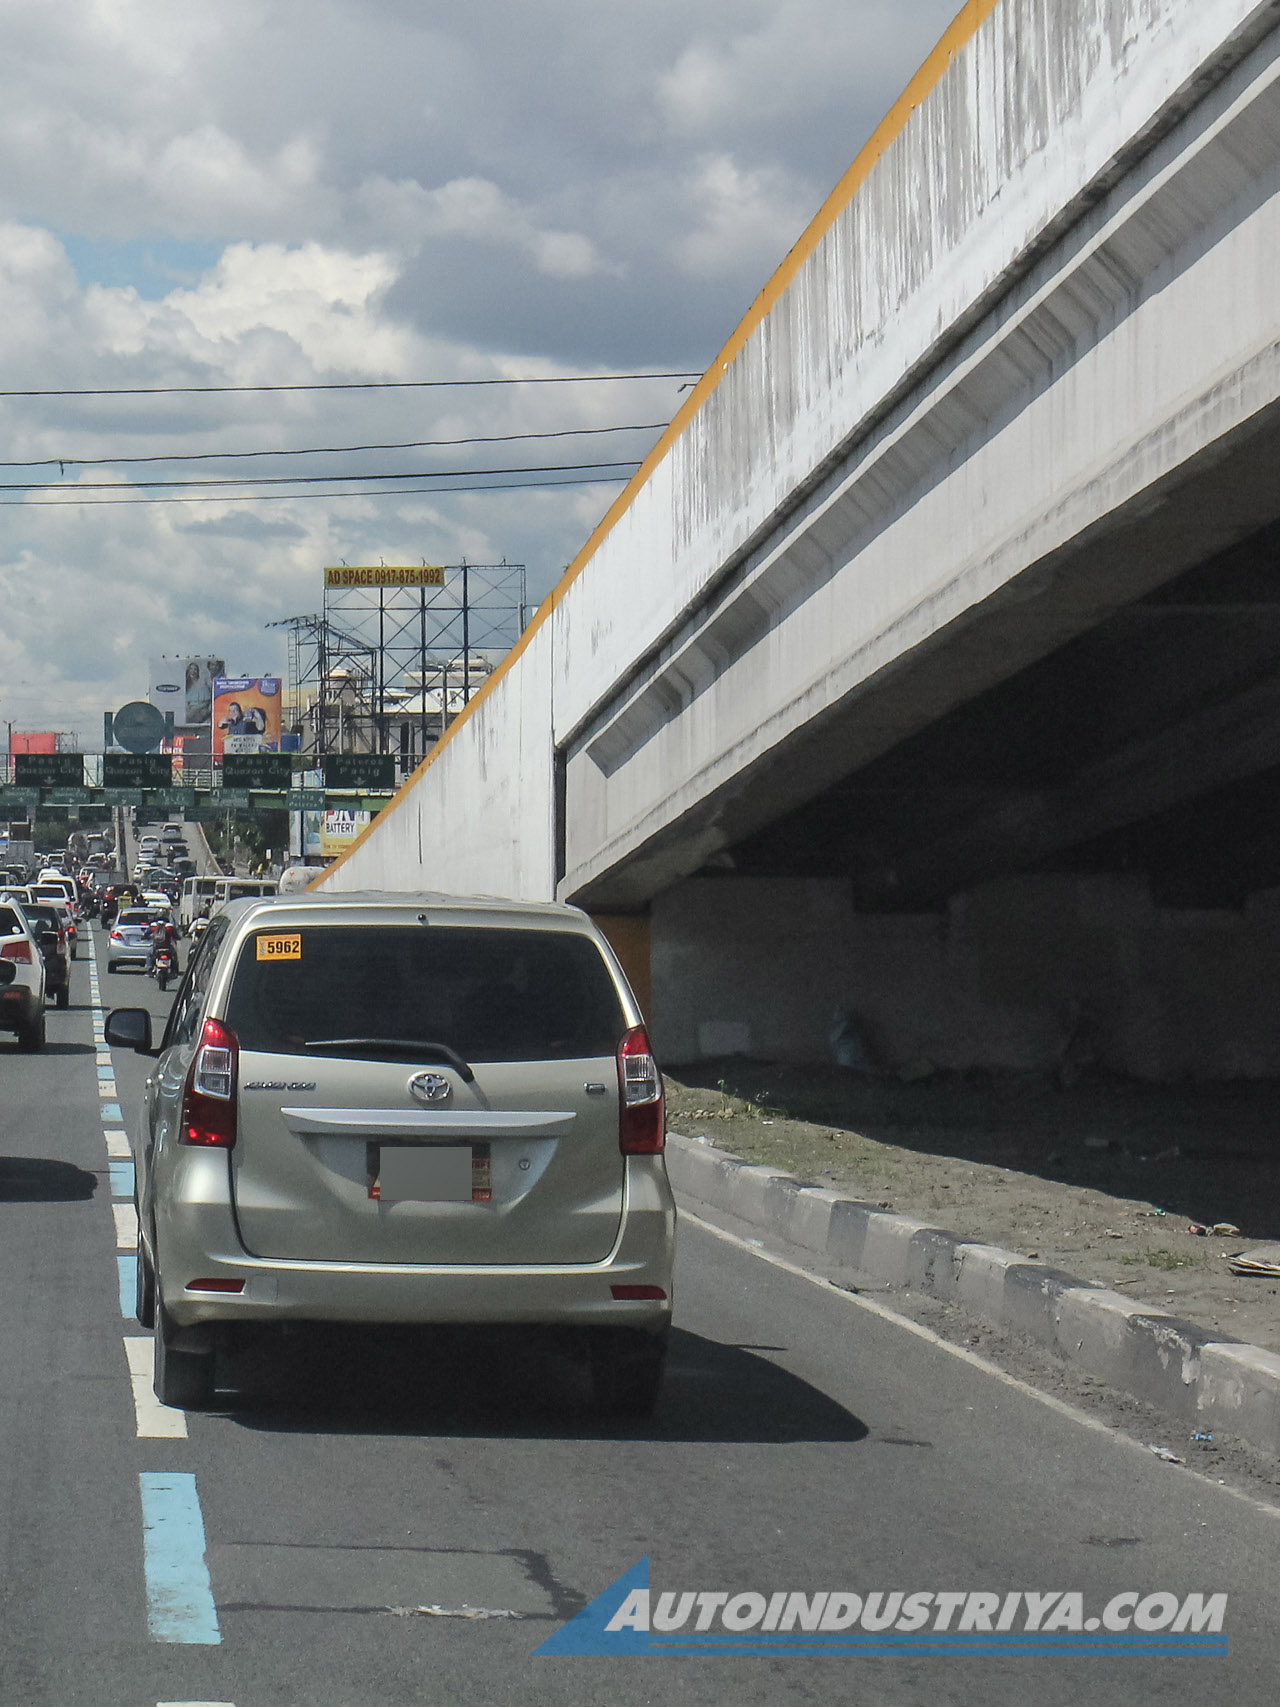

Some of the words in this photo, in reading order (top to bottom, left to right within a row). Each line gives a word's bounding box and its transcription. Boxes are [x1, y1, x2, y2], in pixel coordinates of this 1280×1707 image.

[328, 570, 340, 584] AD
[343, 569, 373, 584] SPACE
[375, 568, 441, 584] 0917-875-1992
[119, 756, 156, 767] Pasig
[236, 757, 279, 768] Pasig
[60, 766, 81, 776] City
[149, 767, 170, 777] City
[225, 767, 264, 775] Quezon
[268, 767, 290, 778] City
[340, 767, 380, 776] Pasig
[326, 822, 355, 833] BATTERY
[267, 940, 300, 954] 5962
